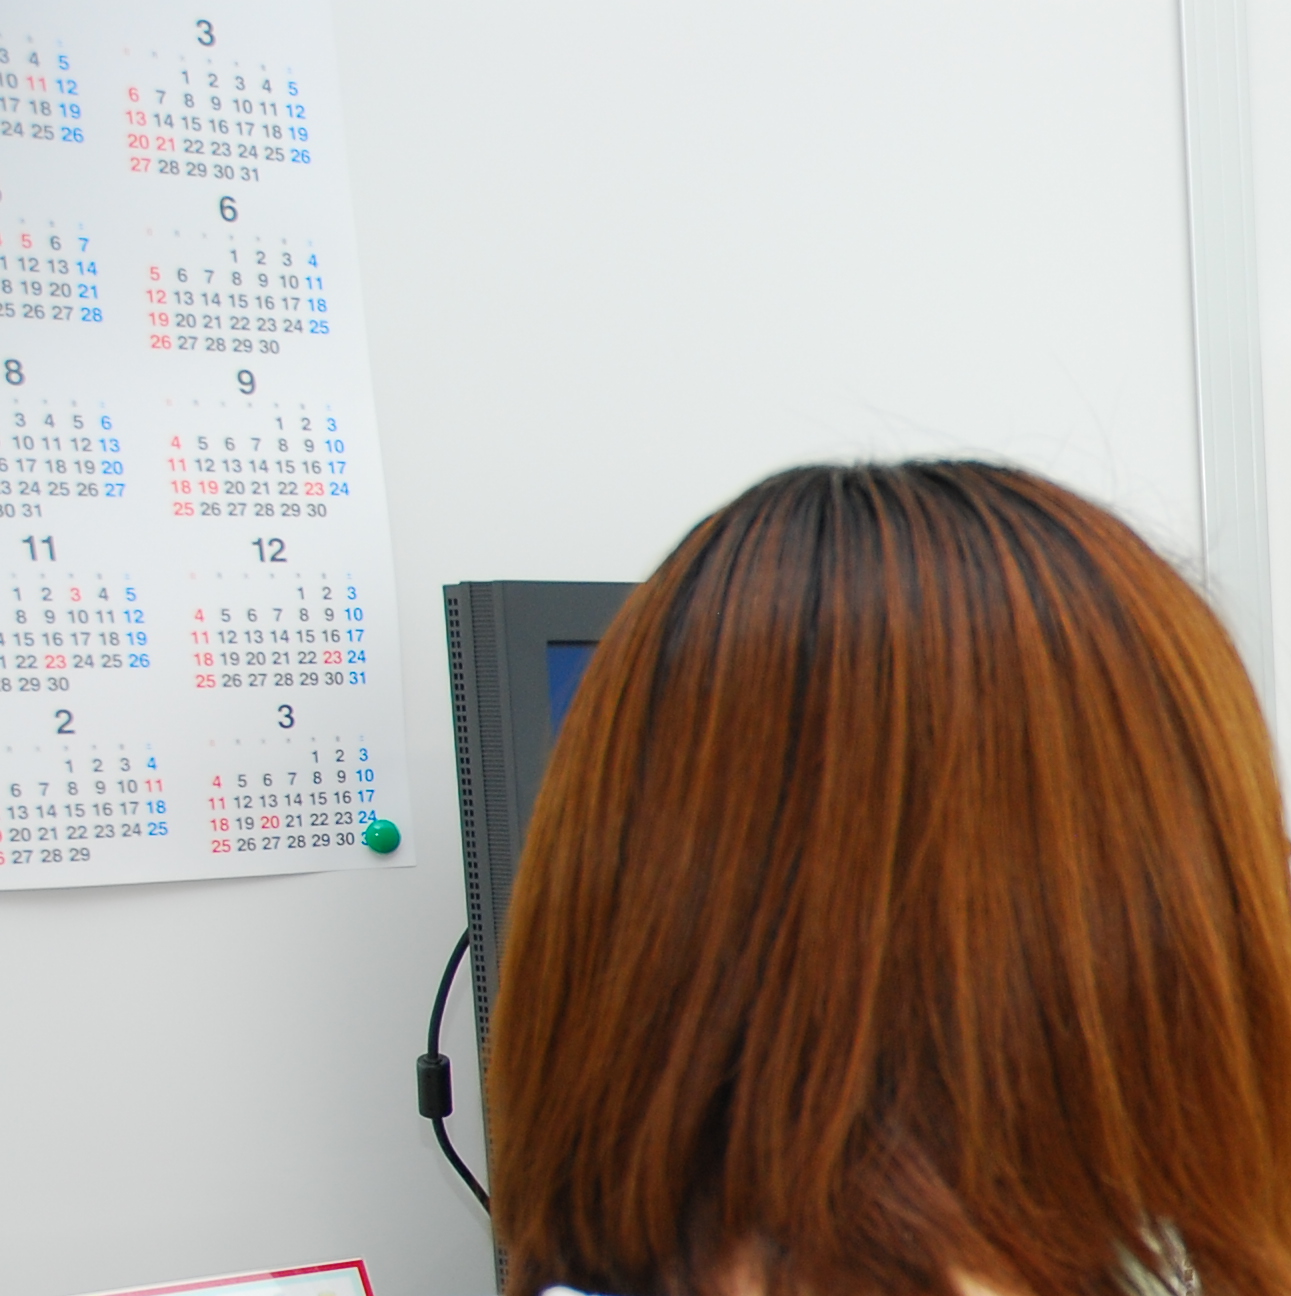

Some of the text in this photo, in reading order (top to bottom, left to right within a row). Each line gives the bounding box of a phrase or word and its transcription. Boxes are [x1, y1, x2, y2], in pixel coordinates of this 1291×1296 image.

[195, 19, 216, 47] 3
[181, 70, 298, 96] 1 2 3 4 5
[129, 87, 305, 119] 6 7 8 9 10 11 12
[219, 195, 238, 222] 6
[3, 358, 25, 386] 8
[236, 369, 256, 395] 9
[276, 417, 337, 432] 1 2 3
[171, 436, 344, 453] 4 5 6 7 8 9 10
[168, 458, 346, 474] 11 12 13 14 15 16 17
[171, 480, 349, 496] 18 19 20 21 22 23 24
[174, 502, 326, 517] 25 26 27 28 29 30
[21, 535, 56, 561] 11
[251, 537, 287, 562] 12
[298, 586, 357, 600] 1 2 3
[195, 607, 363, 622] 4 5 6 7 8 9 10
[192, 629, 364, 644] 11 12 13 14 15 16 17
[194, 649, 366, 666] 18 19 20 21 22 23 24
[196, 671, 366, 688] 25 26 27 28 29 30 31
[54, 709, 75, 734] 2
[277, 704, 295, 729] 3
[312, 748, 368, 763] 1 2 3
[212, 768, 374, 788] 4 5 6 7 8 9 10
[209, 789, 375, 810] 11 12 13 14 15 16 17
[210, 818, 229, 831] 18
[235, 816, 254, 830] 19
[260, 815, 280, 829] 20
[285, 814, 302, 828] 21
[310, 812, 329, 826] 22
[334, 811, 353, 825] 23
[212, 832, 355, 853] 25 26 27 28 29 30
